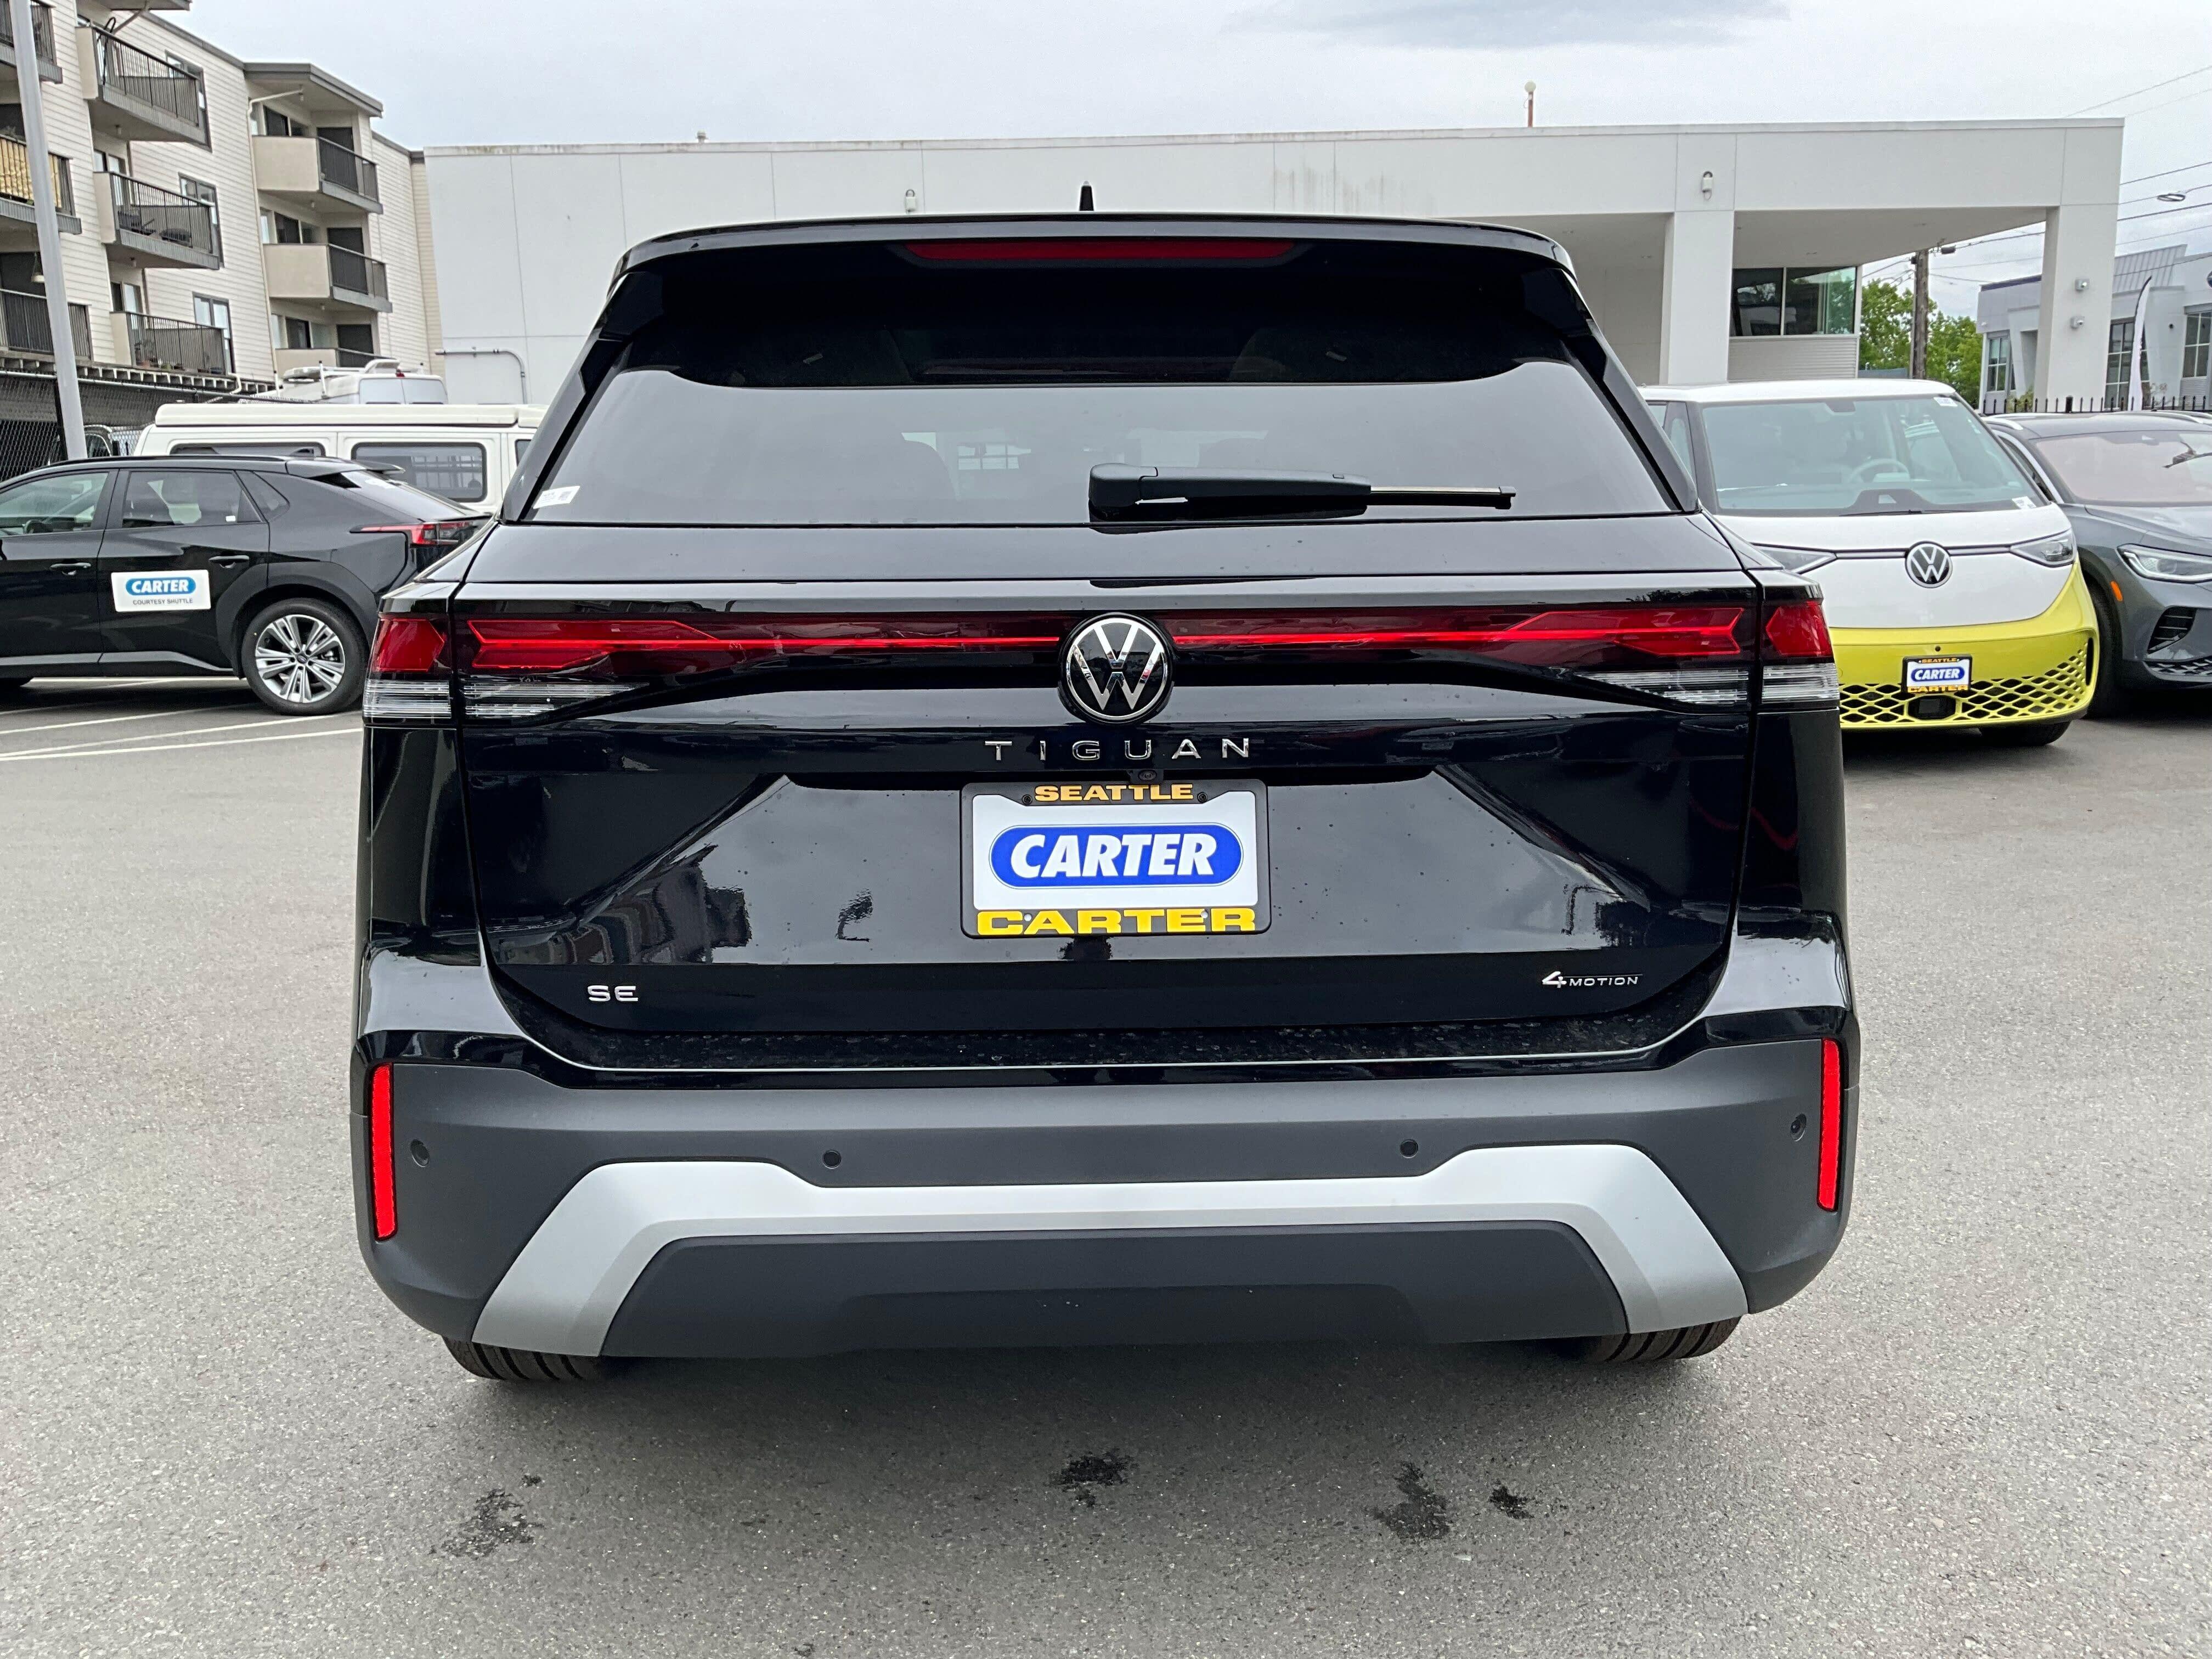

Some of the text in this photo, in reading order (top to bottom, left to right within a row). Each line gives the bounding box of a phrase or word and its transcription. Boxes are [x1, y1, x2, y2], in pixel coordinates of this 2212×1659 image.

[131, 579, 189, 593] CARTER
[1066, 618, 1167, 720] VW
[1915, 668, 1960, 680] CARTER
[1908, 685, 1968, 693] CARTER
[985, 738, 1250, 761] TIGUAN
[1035, 784, 1193, 802] SEATTLE
[1011, 833, 1217, 878] CARTER
[977, 908, 1255, 935] CARTER
[587, 985, 639, 1002] SE
